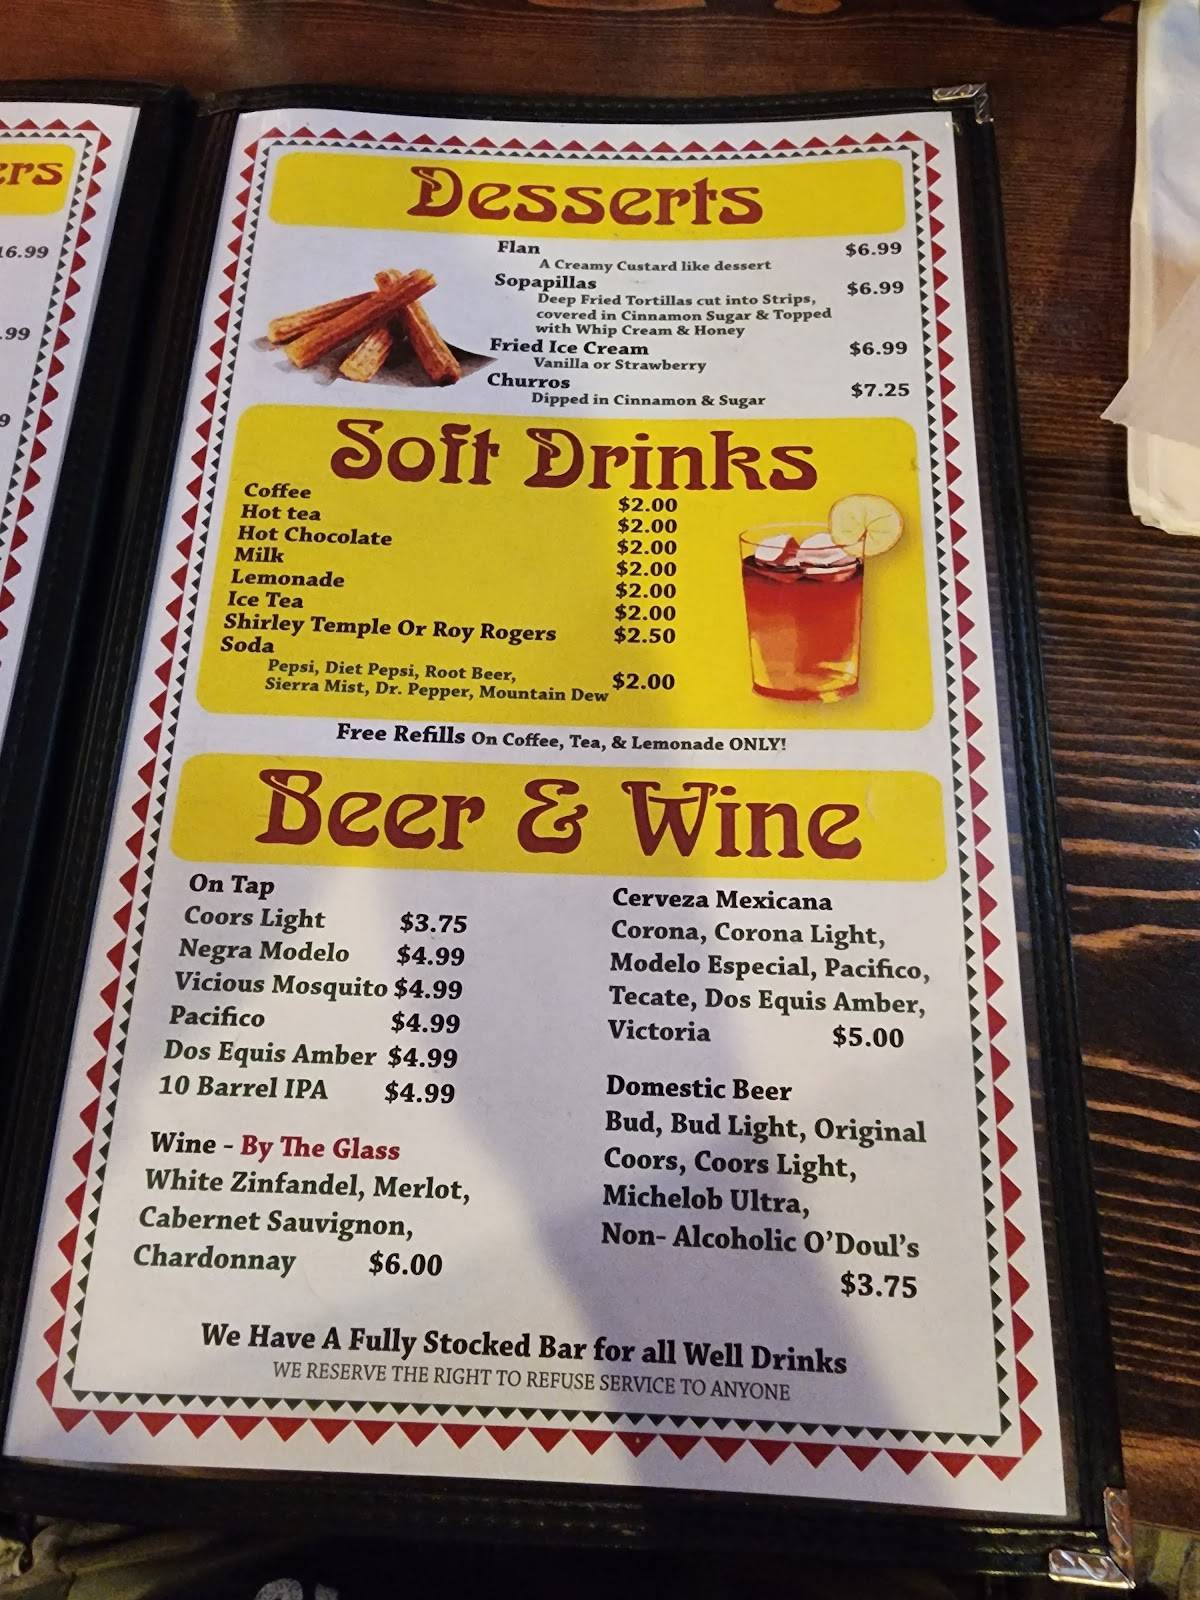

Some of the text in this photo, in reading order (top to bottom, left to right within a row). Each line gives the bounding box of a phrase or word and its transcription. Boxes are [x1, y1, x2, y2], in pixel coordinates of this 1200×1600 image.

[407, 166, 763, 225] Desserts
[498, 240, 901, 257] Flan $6.99
[539, 259, 771, 273] A Creamy Custard like dessert
[495, 273, 903, 296] Sopapillas $6.99
[538, 293, 815, 307] Deep Fried Tortillas cut into Strips,
[537, 308, 832, 324] covered in Cinnamon Sugar & Topped
[490, 338, 907, 356] Fried Ice Cream $6.99
[534, 357, 588, 368] Vanilla
[615, 359, 706, 373] Strawberry
[488, 373, 909, 398] Churros $7.25
[331, 419, 817, 490] Soft Drinks
[245, 483, 677, 513] Coffee $2.00
[238, 526, 676, 555] Hot Chocolate $2.00
[234, 547, 676, 577] Milk $2.00
[231, 569, 676, 599] Lemonade $2.00
[224, 613, 675, 645] Shirley Temple Or Roy Rogers $2.50
[221, 636, 274, 653] Soda
[268, 659, 515, 683] Pepsi, Diet Pepsi, Root Beer,
[613, 672, 675, 690] $2.00
[265, 677, 608, 701] Sierra Mist, Dr. Pepper, Mountain Dew
[337, 723, 786, 752] Free Refills On Coffee, Tea, & Lemonade ONLY!
[255, 769, 862, 859] Beer & Wine
[190, 874, 274, 900] On Tap
[613, 888, 832, 910] Cerveza Mexicana
[185, 906, 467, 934] Coors Light $3.75
[612, 920, 885, 950] Corona, Corona Light,
[179, 938, 464, 966] Negra Modelo $4.99
[610, 953, 929, 984] Modelo Especial, Pacifico,
[175, 971, 462, 1001] Vicious Mosquito $4.99
[609, 986, 925, 1018] Tecate, Dos Equis Amber,
[169, 1005, 460, 1033] Pacifico $4.99
[608, 1019, 904, 1048] Victoria $5.00
[164, 1039, 457, 1068] Dos Equis Amber $4.99
[159, 1075, 454, 1104] 10 Barrel IPA $4.99
[607, 1075, 792, 1100] Domestic Beer
[606, 1110, 926, 1148] Bud, Bud Light, Original
[605, 1147, 856, 1183] Coors, Coors Light,
[146, 1168, 469, 1205] White Zinfandel, Merlot,
[603, 1184, 809, 1219] Michelob Ultra,
[140, 1206, 412, 1241] Cabernet Sauvignon,
[602, 1222, 666, 1245] Non-
[673, 1224, 796, 1252] Alcoholic
[134, 1244, 442, 1278] Chardonnay $6.00
[841, 1270, 917, 1298] $3.75
[202, 1323, 847, 1374] We Have A Fully Stocked Bar for all Well Drinks
[273, 1361, 790, 1400] WE RESERVE THE RIGHT TO REFUSE SERVICE TO ANYONE
